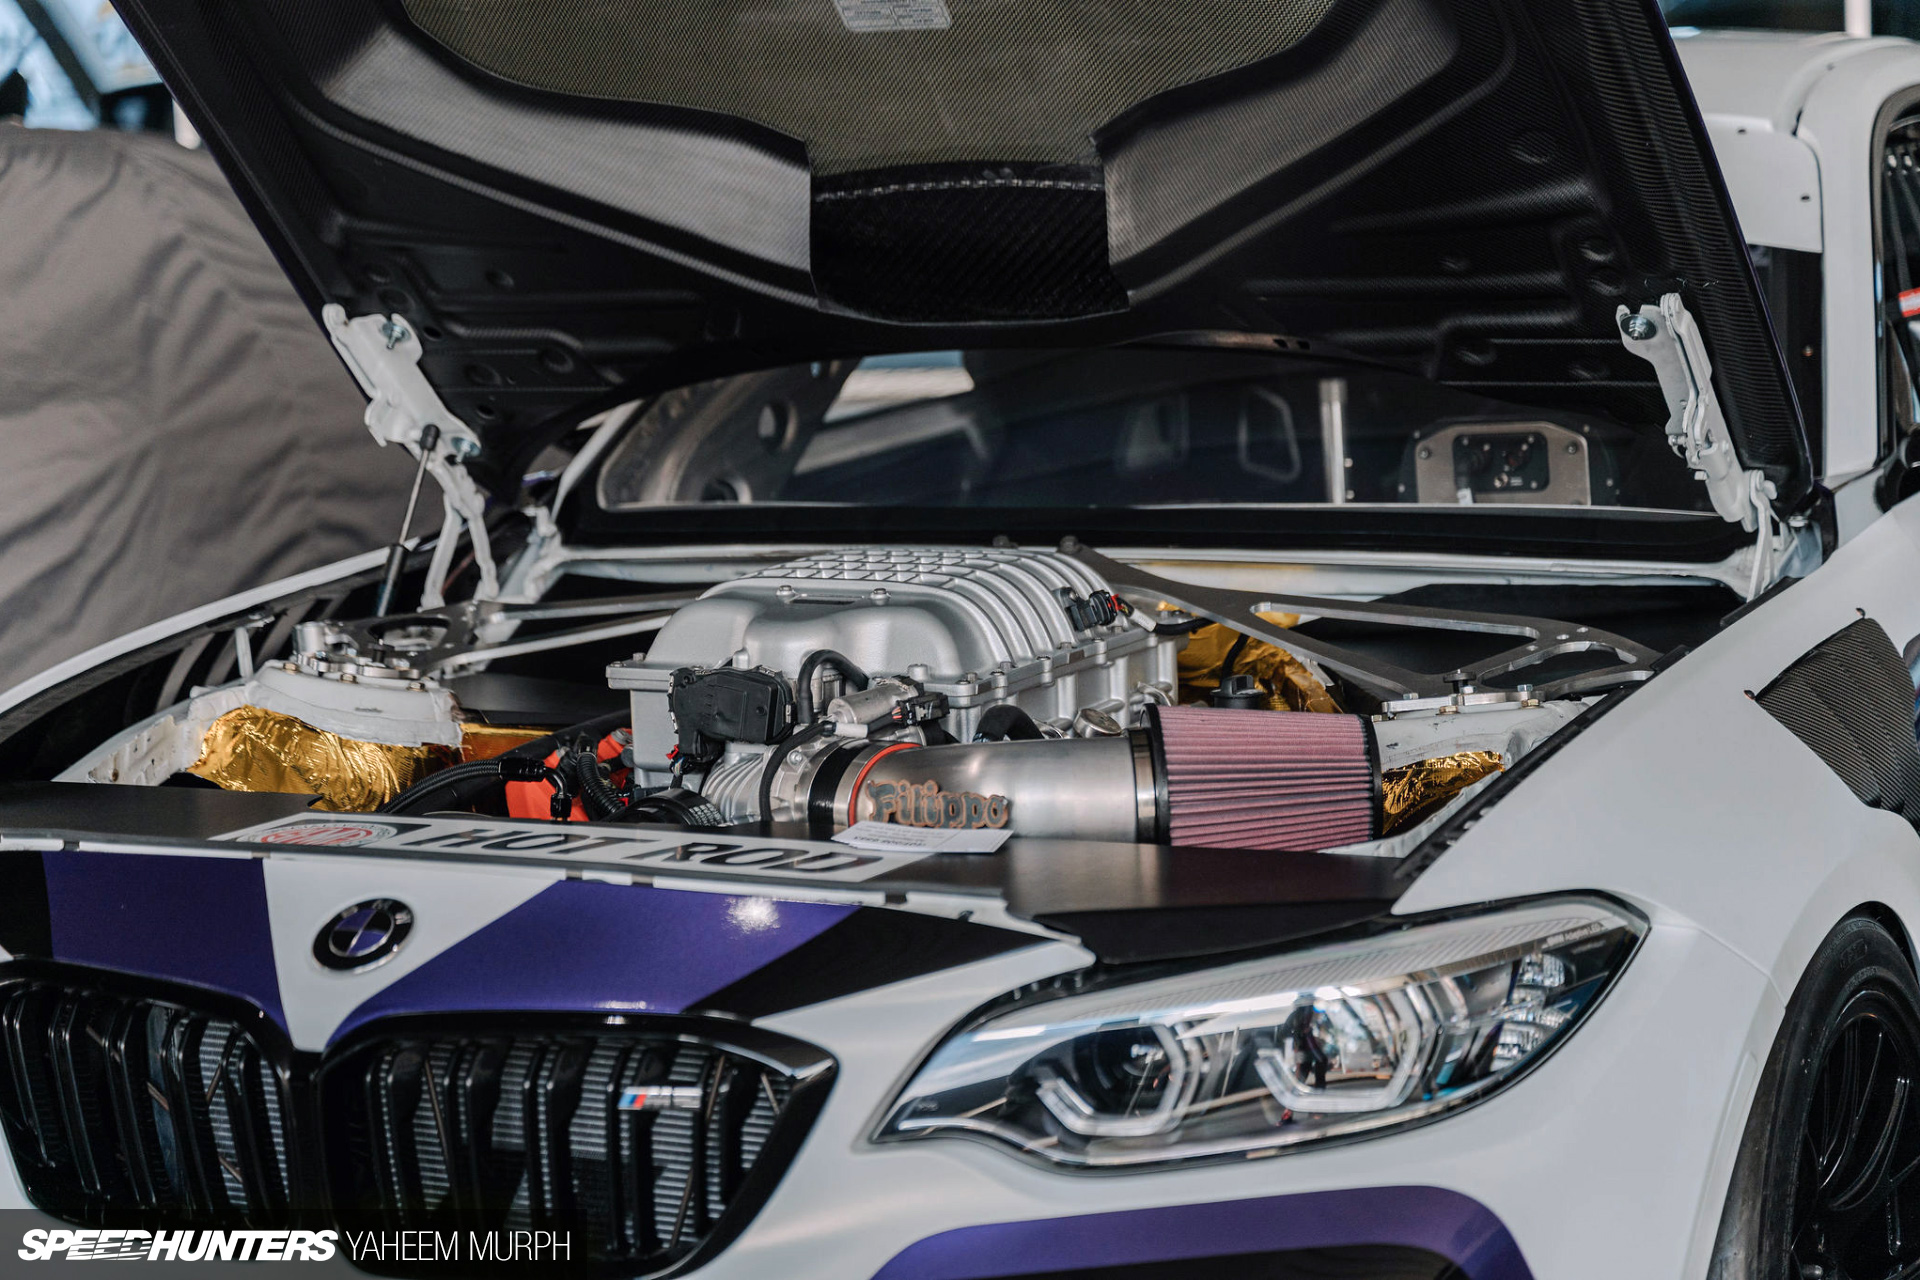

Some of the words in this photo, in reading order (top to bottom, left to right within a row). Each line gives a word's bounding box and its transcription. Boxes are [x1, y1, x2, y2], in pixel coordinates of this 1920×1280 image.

[865, 779, 1010, 829] Filippo
[401, 829, 657, 855] HOT
[622, 842, 884, 873] ROD
